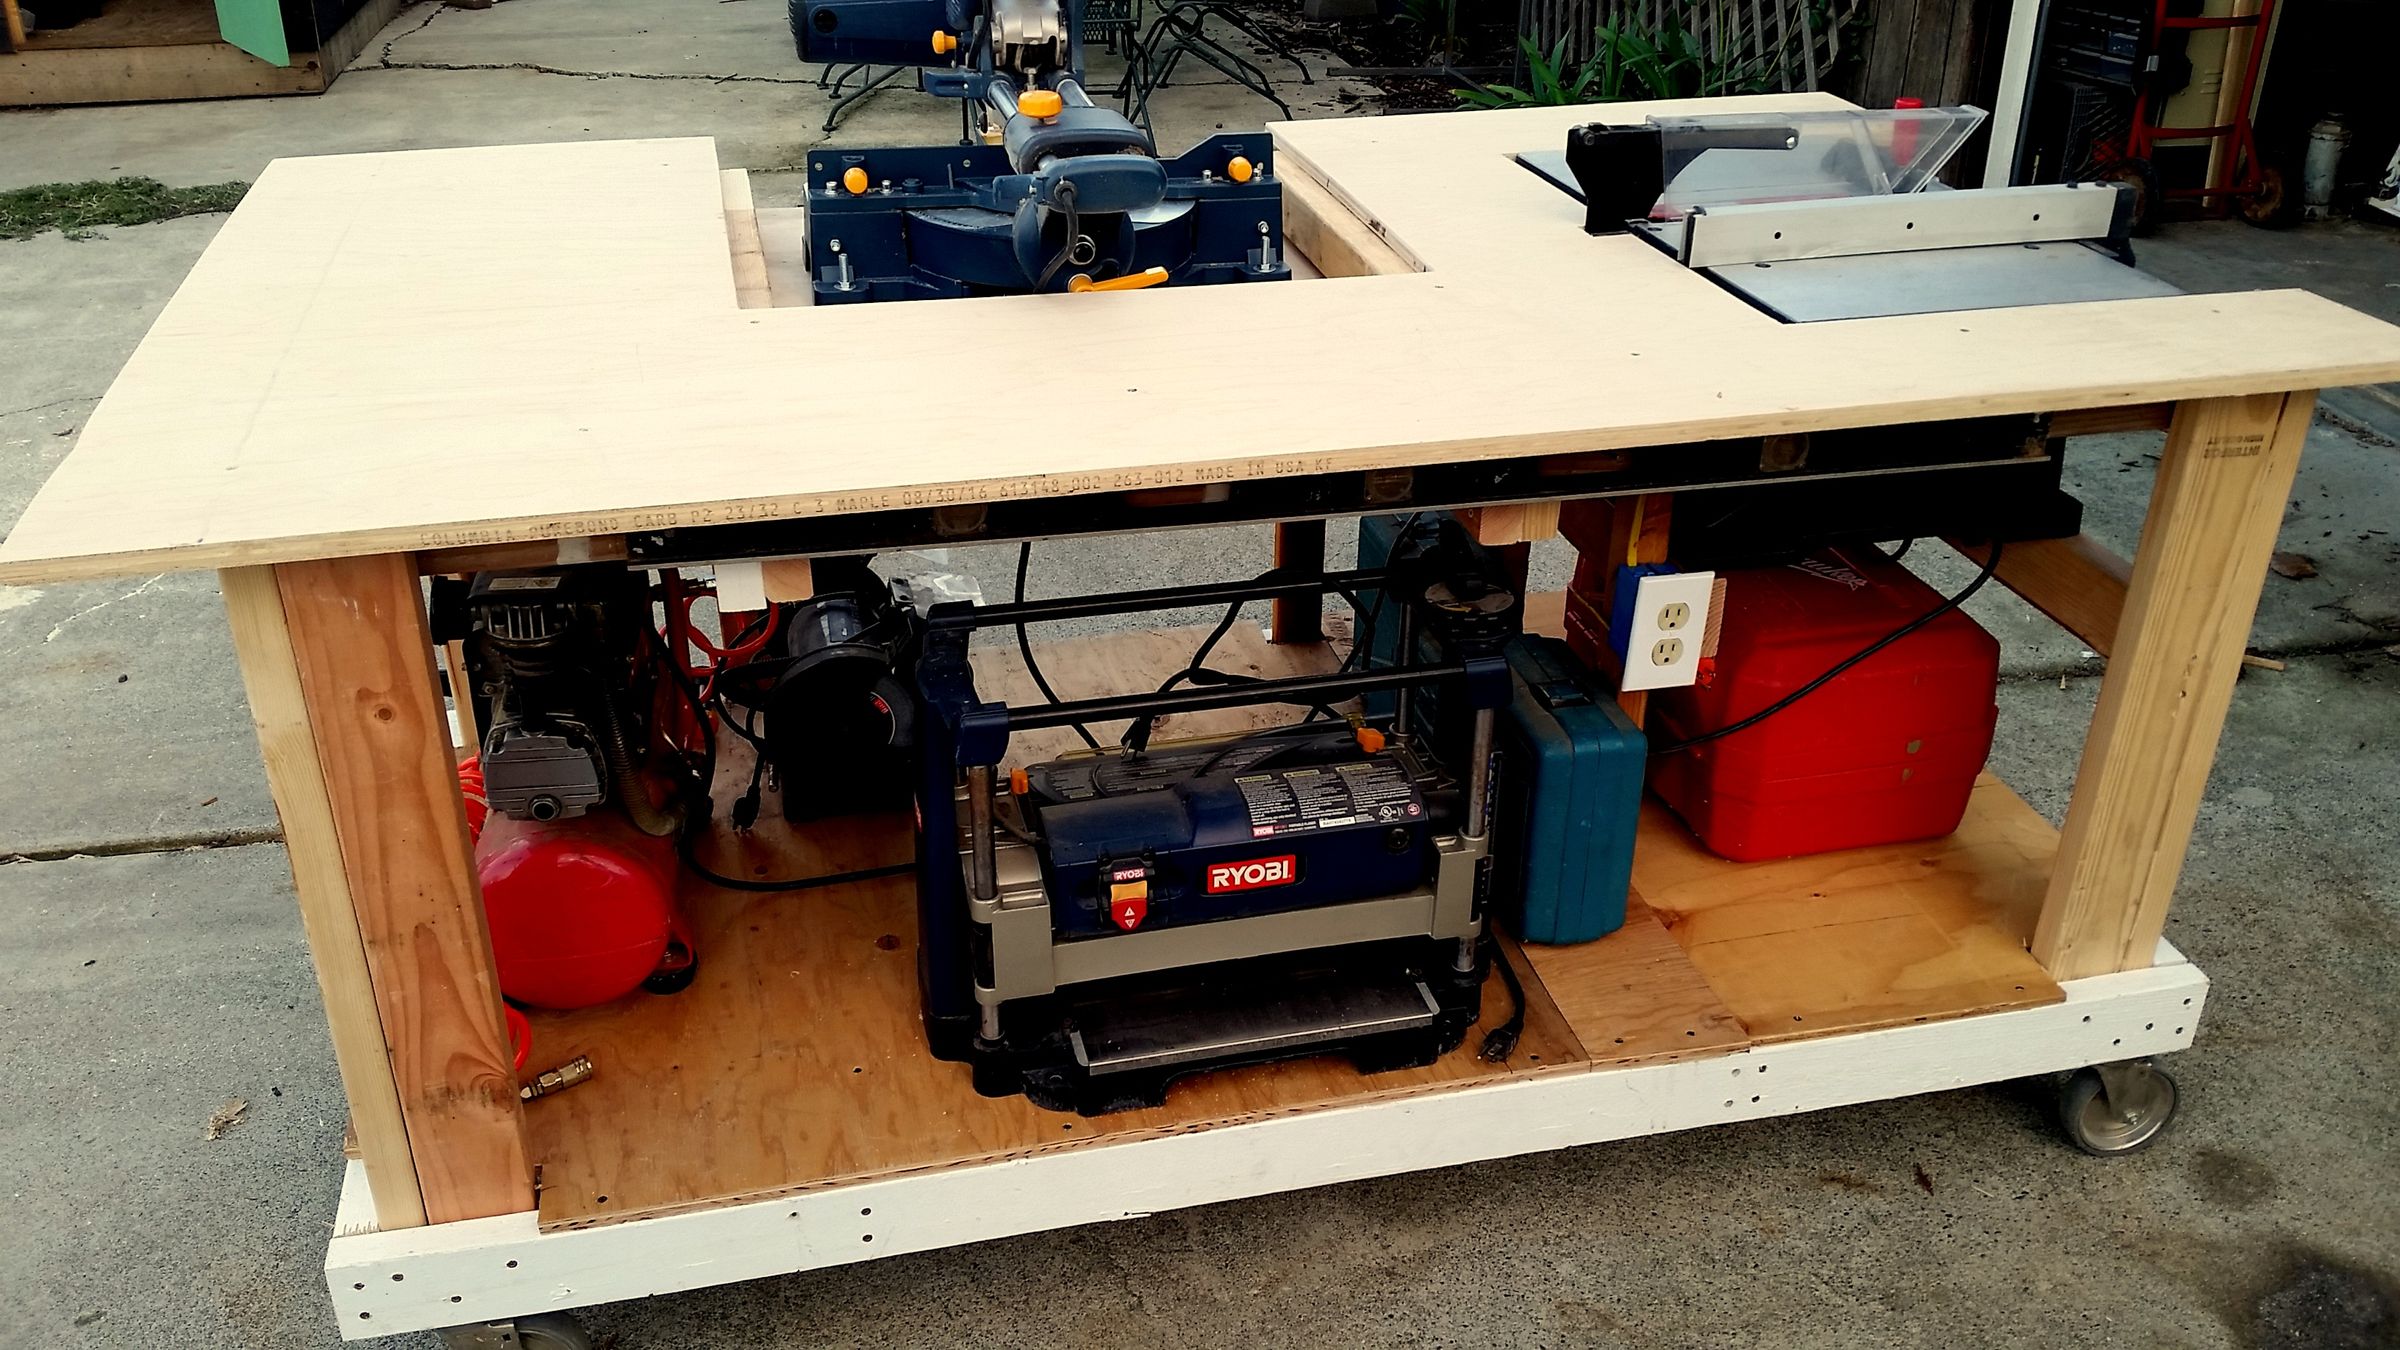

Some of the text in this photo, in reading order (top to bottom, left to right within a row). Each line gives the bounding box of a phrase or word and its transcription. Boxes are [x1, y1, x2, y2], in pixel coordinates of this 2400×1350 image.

[420, 528, 516, 546] COLUMBIA
[633, 512, 677, 528] CARB
[725, 503, 779, 520] 23/32
[793, 502, 802, 515] C
[816, 498, 824, 513] 3
[837, 494, 890, 511] MAPLE
[903, 485, 988, 506] 08/30/16
[1114, 469, 1184, 488] 263-012
[1196, 465, 1235, 481] MADE
[1247, 460, 1265, 476] IN
[1275, 460, 1304, 474] USA
[1113, 868, 1145, 881] RYOBI
[1212, 860, 1289, 888] RYOBI
